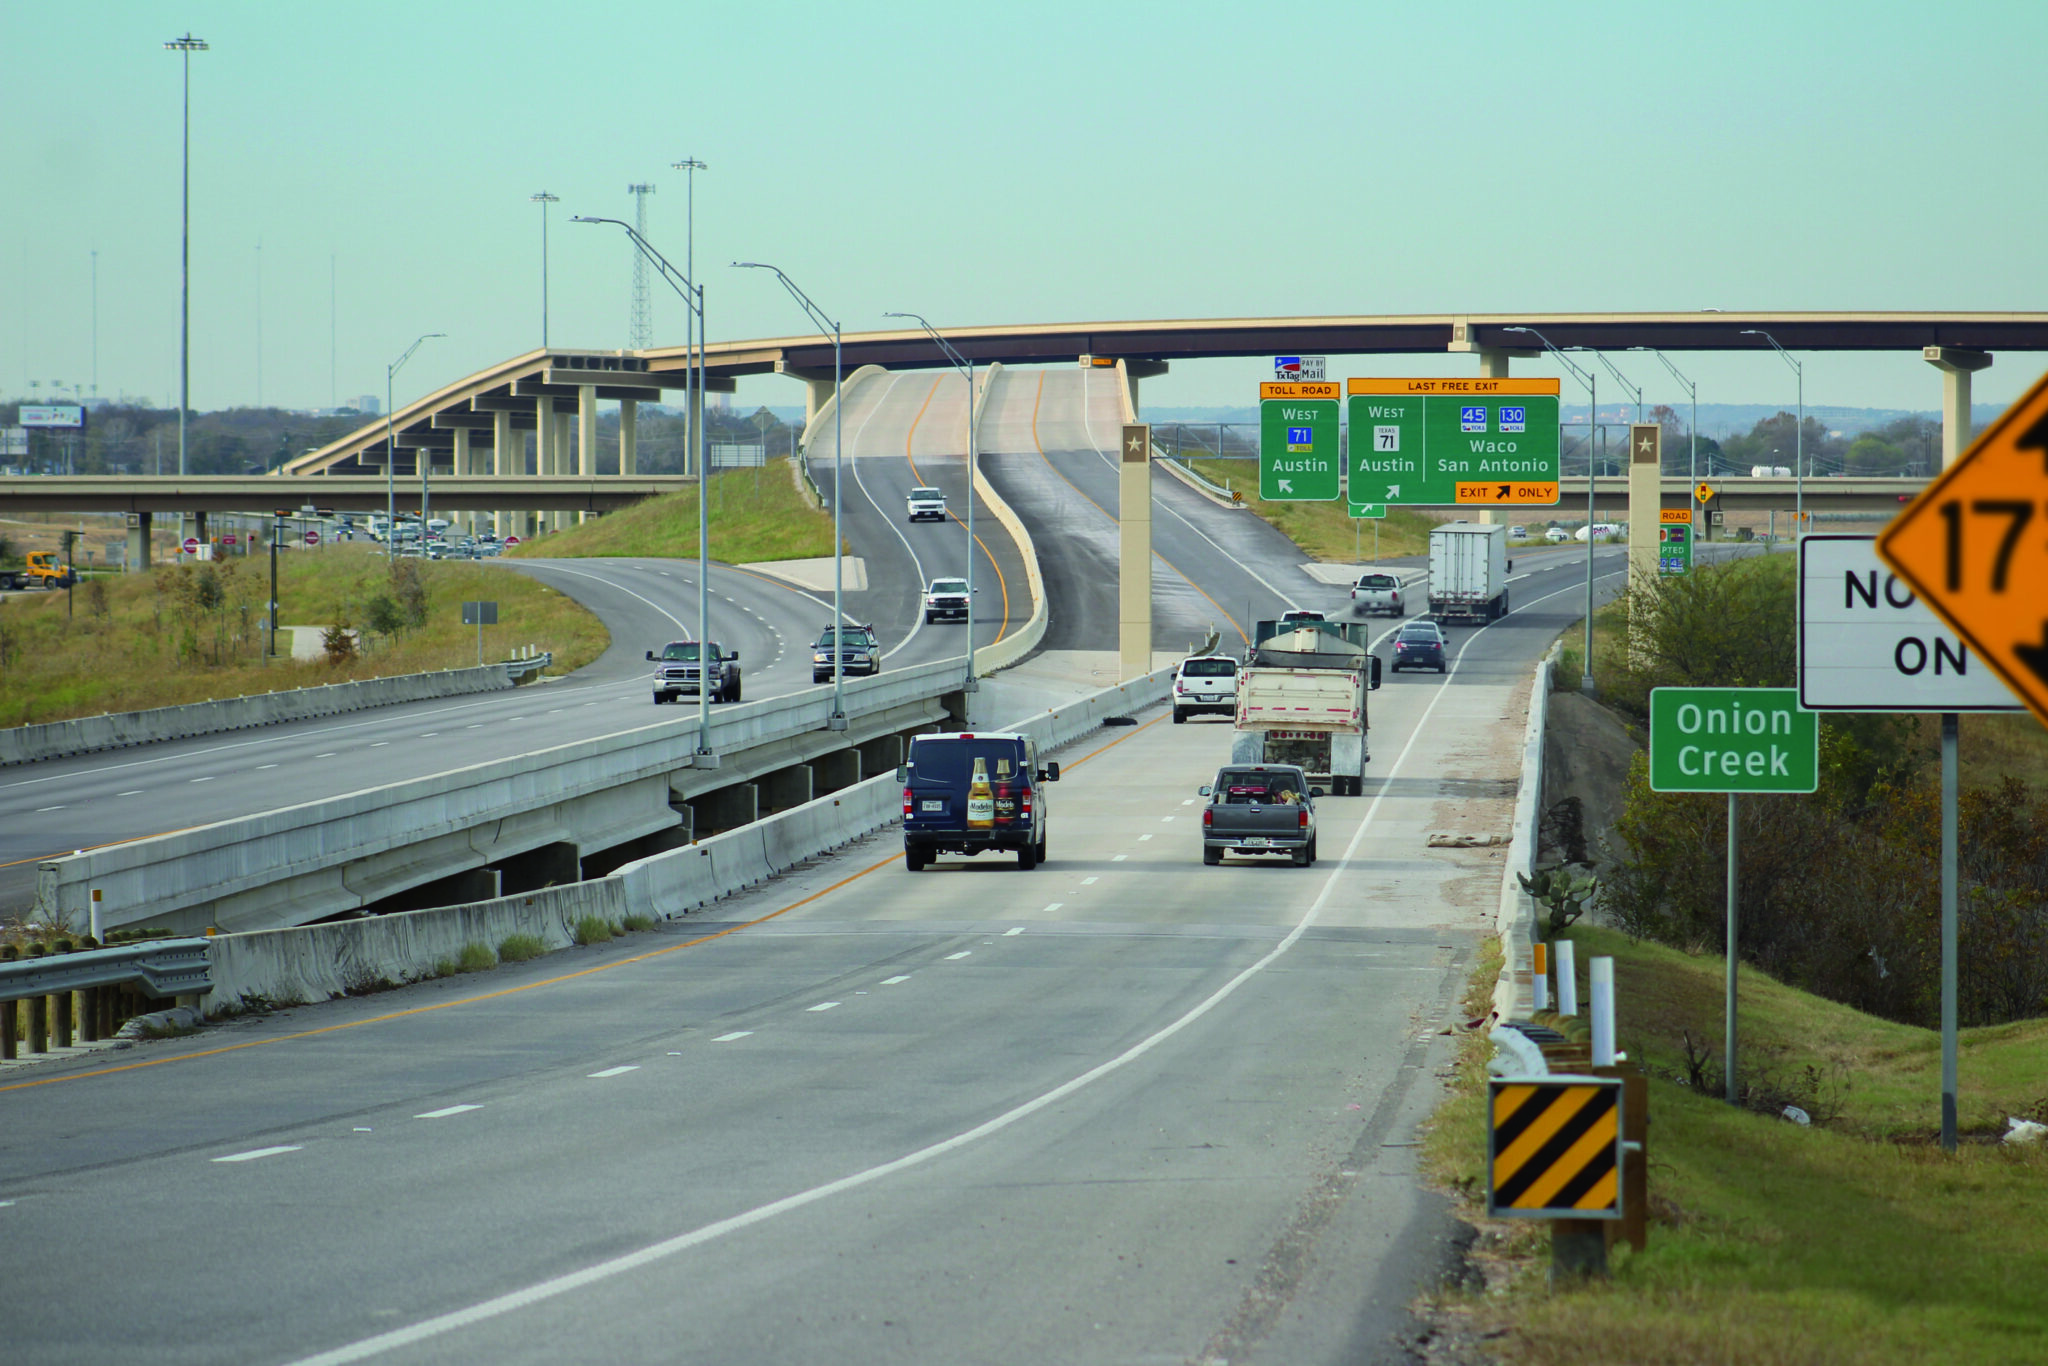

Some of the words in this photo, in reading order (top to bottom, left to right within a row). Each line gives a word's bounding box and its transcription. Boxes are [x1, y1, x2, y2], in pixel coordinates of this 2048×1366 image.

[1275, 371, 1300, 382] TxTag
[1301, 369, 1324, 379] Mail
[1269, 386, 1295, 394] TOLL
[1302, 386, 1331, 394] ROAD
[1408, 382, 1436, 391] LAST
[1442, 382, 1469, 391] FREE
[1475, 382, 1498, 391] EXIT
[1281, 408, 1318, 420] WEST
[1368, 406, 1405, 418] WEST
[1462, 408, 1485, 421] 45
[1501, 408, 1523, 421] 130
[1293, 429, 1307, 442] 71
[1380, 435, 1394, 448] 71
[1469, 440, 1517, 453] Waco
[1272, 457, 1328, 472] Austin
[1359, 458, 1414, 472] Austin
[1438, 459, 1469, 472] San
[1479, 458, 1549, 472] Antonio
[1460, 487, 1488, 497] EXIT
[1518, 487, 1552, 497] ONLY
[1662, 512, 1688, 520] ROAD
[1660, 546, 1684, 554] PTED
[1939, 499, 2048, 593] 17
[1894, 636, 1967, 675] ON
[1677, 702, 1791, 734] Onion
[1678, 744, 1789, 776] Creek
